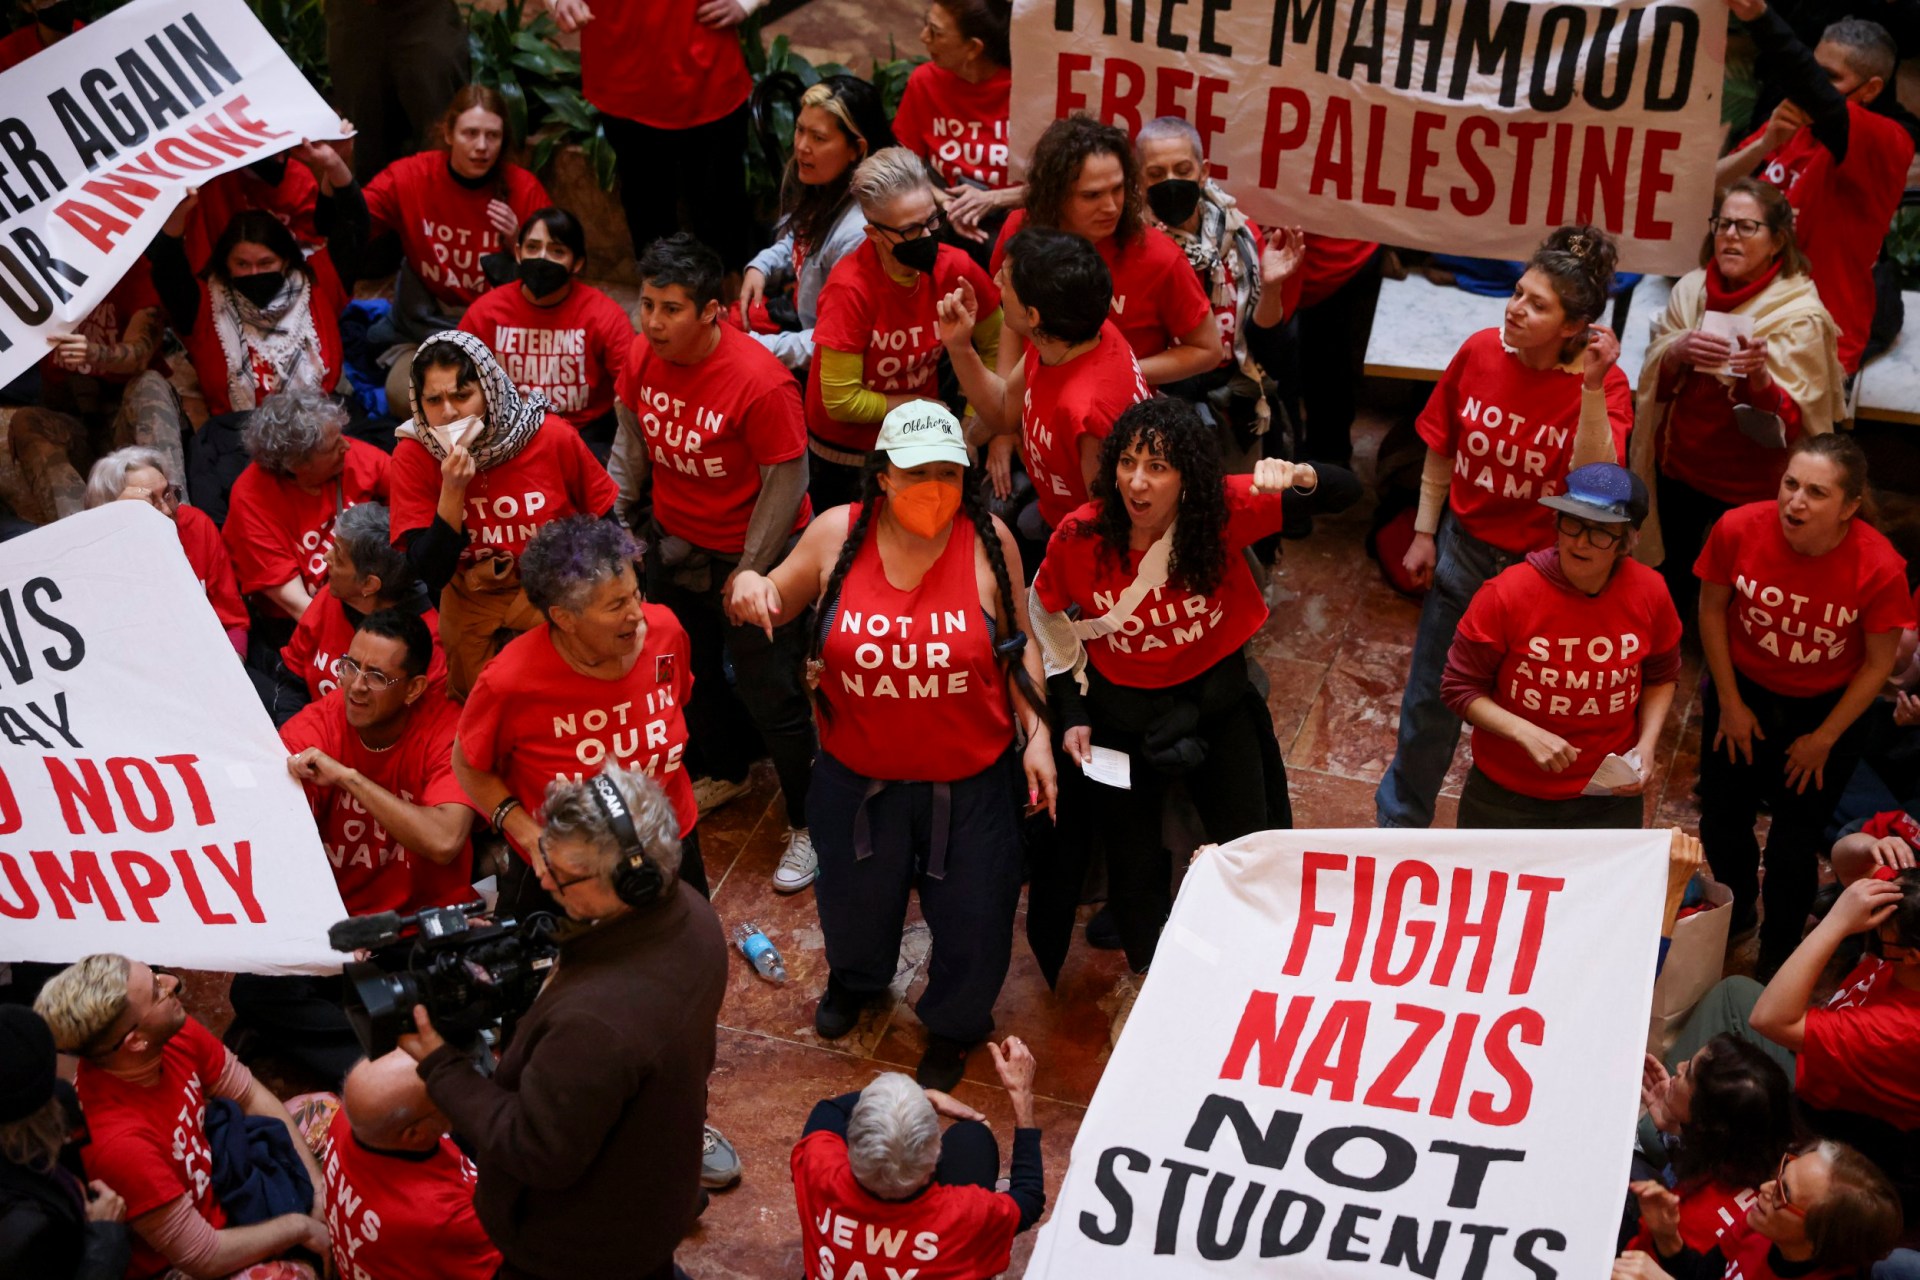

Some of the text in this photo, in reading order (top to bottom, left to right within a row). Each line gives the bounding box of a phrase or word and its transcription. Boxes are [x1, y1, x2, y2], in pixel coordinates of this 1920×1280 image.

[1268, 0, 1700, 112] MAHMOUD
[47, 12, 243, 173] AGAIN
[933, 117, 982, 140] NOT
[938, 140, 1009, 167] OUR
[1259, 87, 1682, 240] PALESTINE
[0, 94, 295, 352] OR ANYONE
[423, 218, 472, 248] NOT
[421, 260, 496, 294] NAM
[495, 325, 587, 355] VETERANS
[870, 326, 924, 351] NOT
[496, 353, 587, 386] AGAINST
[640, 385, 724, 434] NOT IN
[1461, 396, 1569, 449] NOT IN
[642, 412, 703, 454] OUR
[1032, 416, 1053, 451] IN
[1467, 430, 1547, 477] OUR
[644, 437, 728, 478] AME
[1454, 449, 1558, 499] NAME
[1093, 584, 1167, 611] NT
[1119, 594, 1209, 637] OUR
[1736, 574, 1859, 628] NOT IN
[840, 609, 967, 639] NOT IN
[1748, 606, 1837, 648] OUR
[854, 641, 951, 670] OUR
[1527, 633, 1640, 663] STOP
[841, 670, 969, 699] NAME
[1510, 678, 1639, 716] ISRAEL
[553, 685, 675, 738] NOT IN
[575, 719, 669, 766] OUR
[42, 754, 216, 834] NOT
[1282, 851, 1565, 995] FIGHT
[1218, 989, 1545, 1126] NAZIS
[1184, 1094, 1526, 1209] NOT
[816, 1207, 940, 1261] JEWS
[1079, 1146, 1567, 1280] STUDENTS
